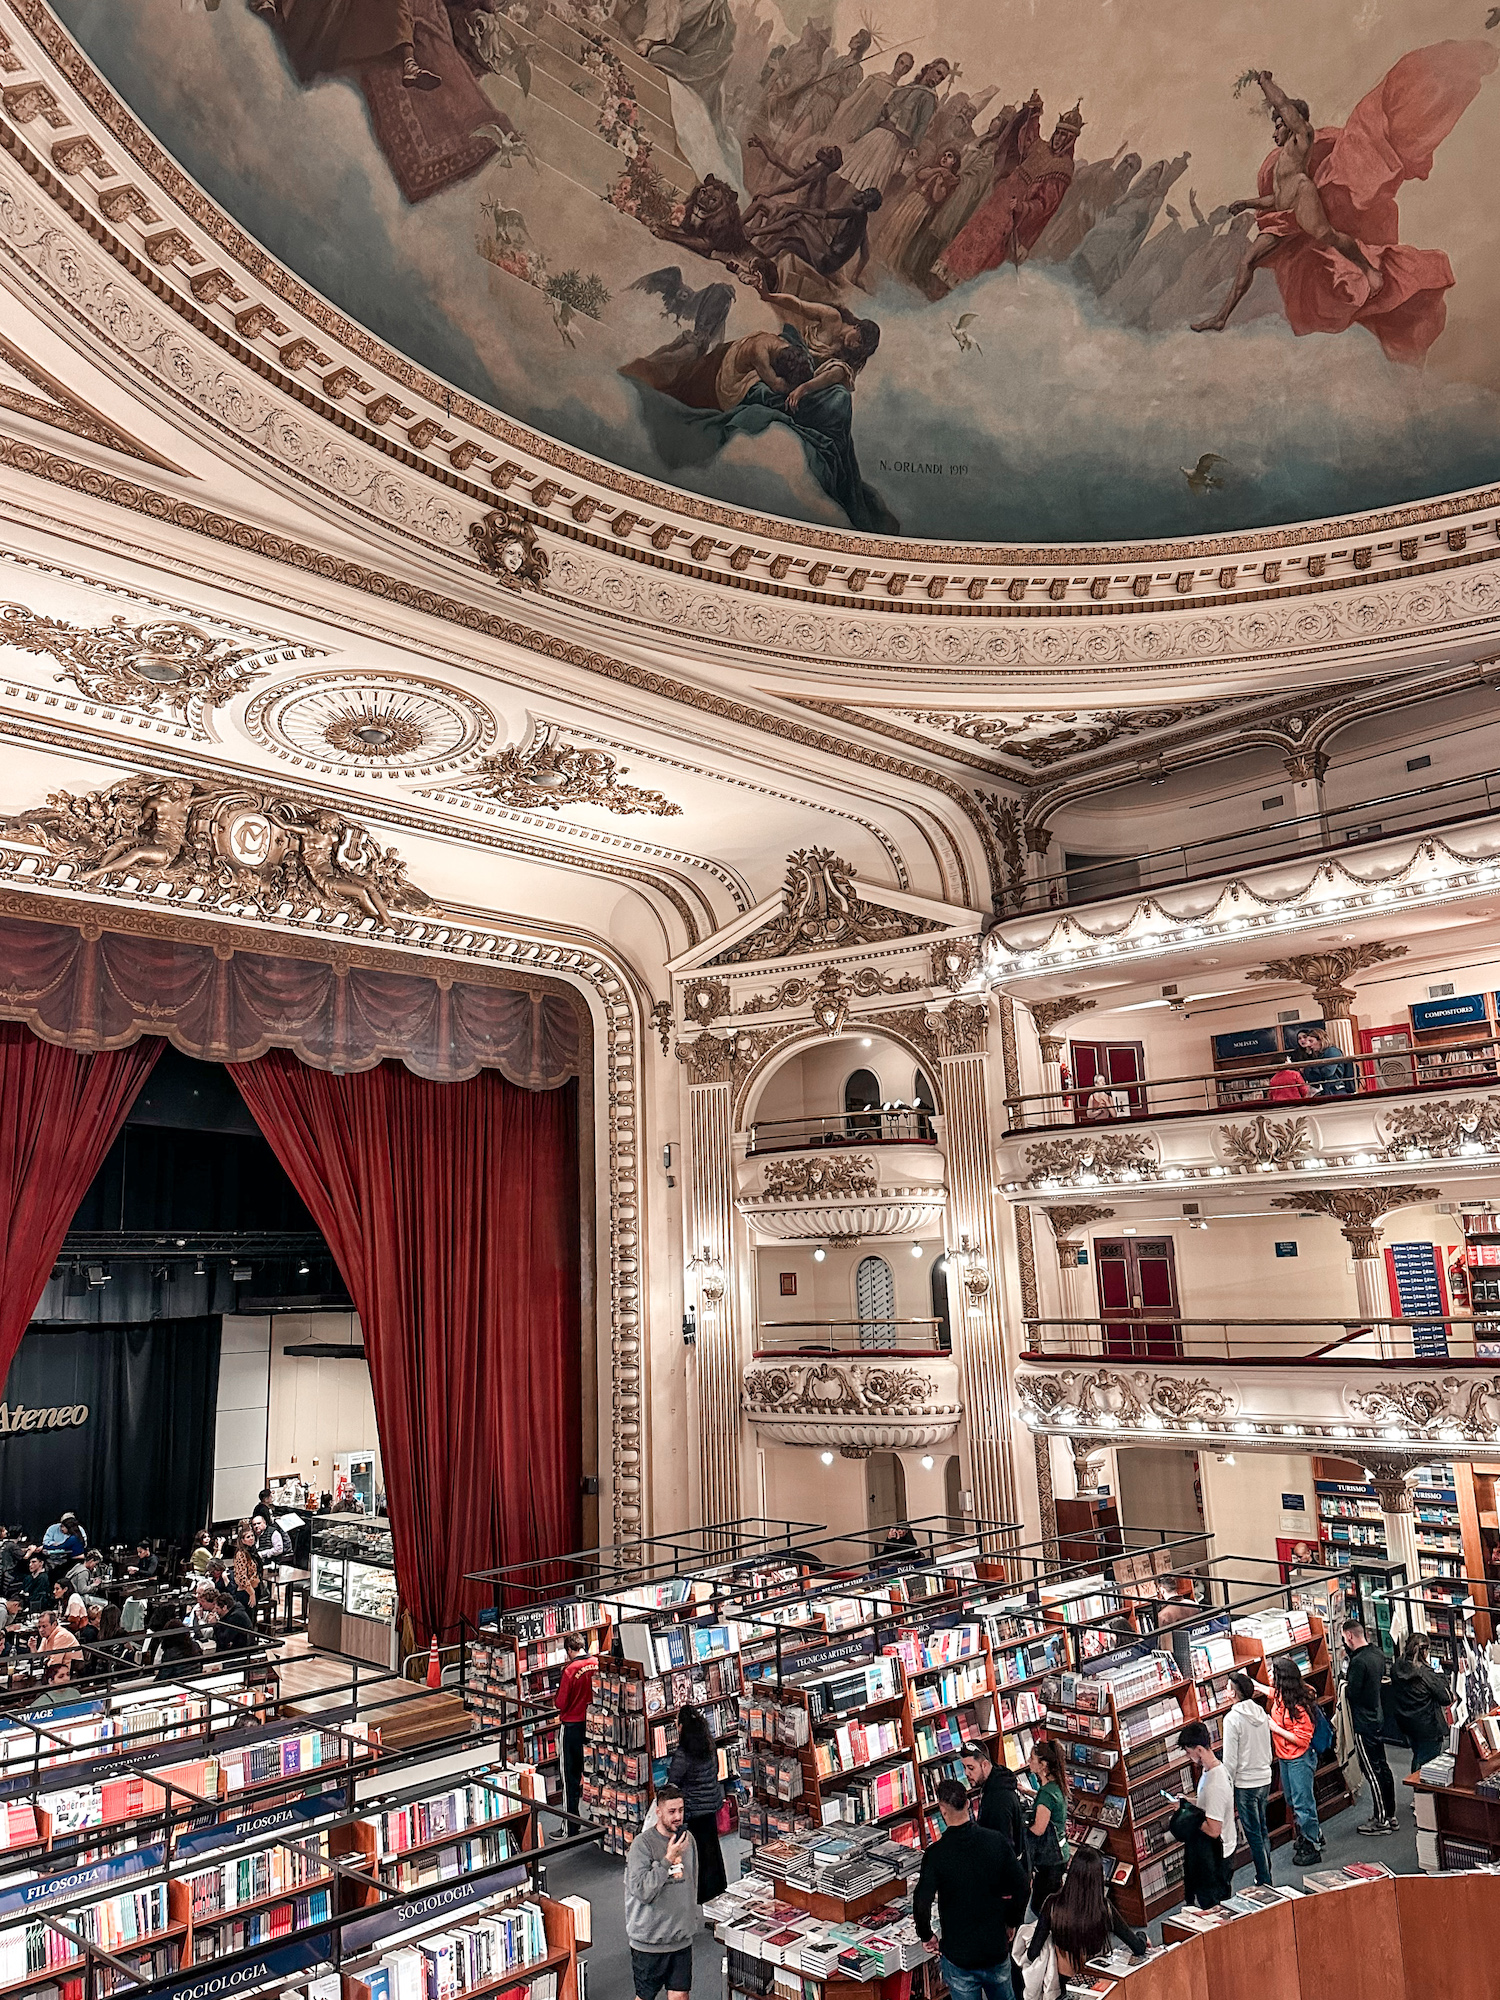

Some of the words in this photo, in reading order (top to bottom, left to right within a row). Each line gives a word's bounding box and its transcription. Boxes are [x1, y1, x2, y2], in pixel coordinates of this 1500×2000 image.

[893, 461, 943, 475] ORLANDI
[949, 464, 969, 476] 1919
[1424, 1005, 1474, 1019] COMPOSITORES
[0, 1402, 89, 1432] Ateneo
[1337, 1484, 1367, 1493] TURISMO
[1412, 1491, 1442, 1500] TURISMO
[1192, 1625, 1210, 1636] COMICS
[796, 1653, 827, 1667] TECNICAS
[828, 1643, 862, 1659] ARTISTICAS
[1112, 1649, 1132, 1662] COMICS
[33, 1708, 54, 1720] AGE
[235, 1809, 294, 1836] FILOSOFIA
[26, 1869, 99, 1900] FILOSOFIA
[398, 1882, 475, 1922] SOCIOLOGIA
